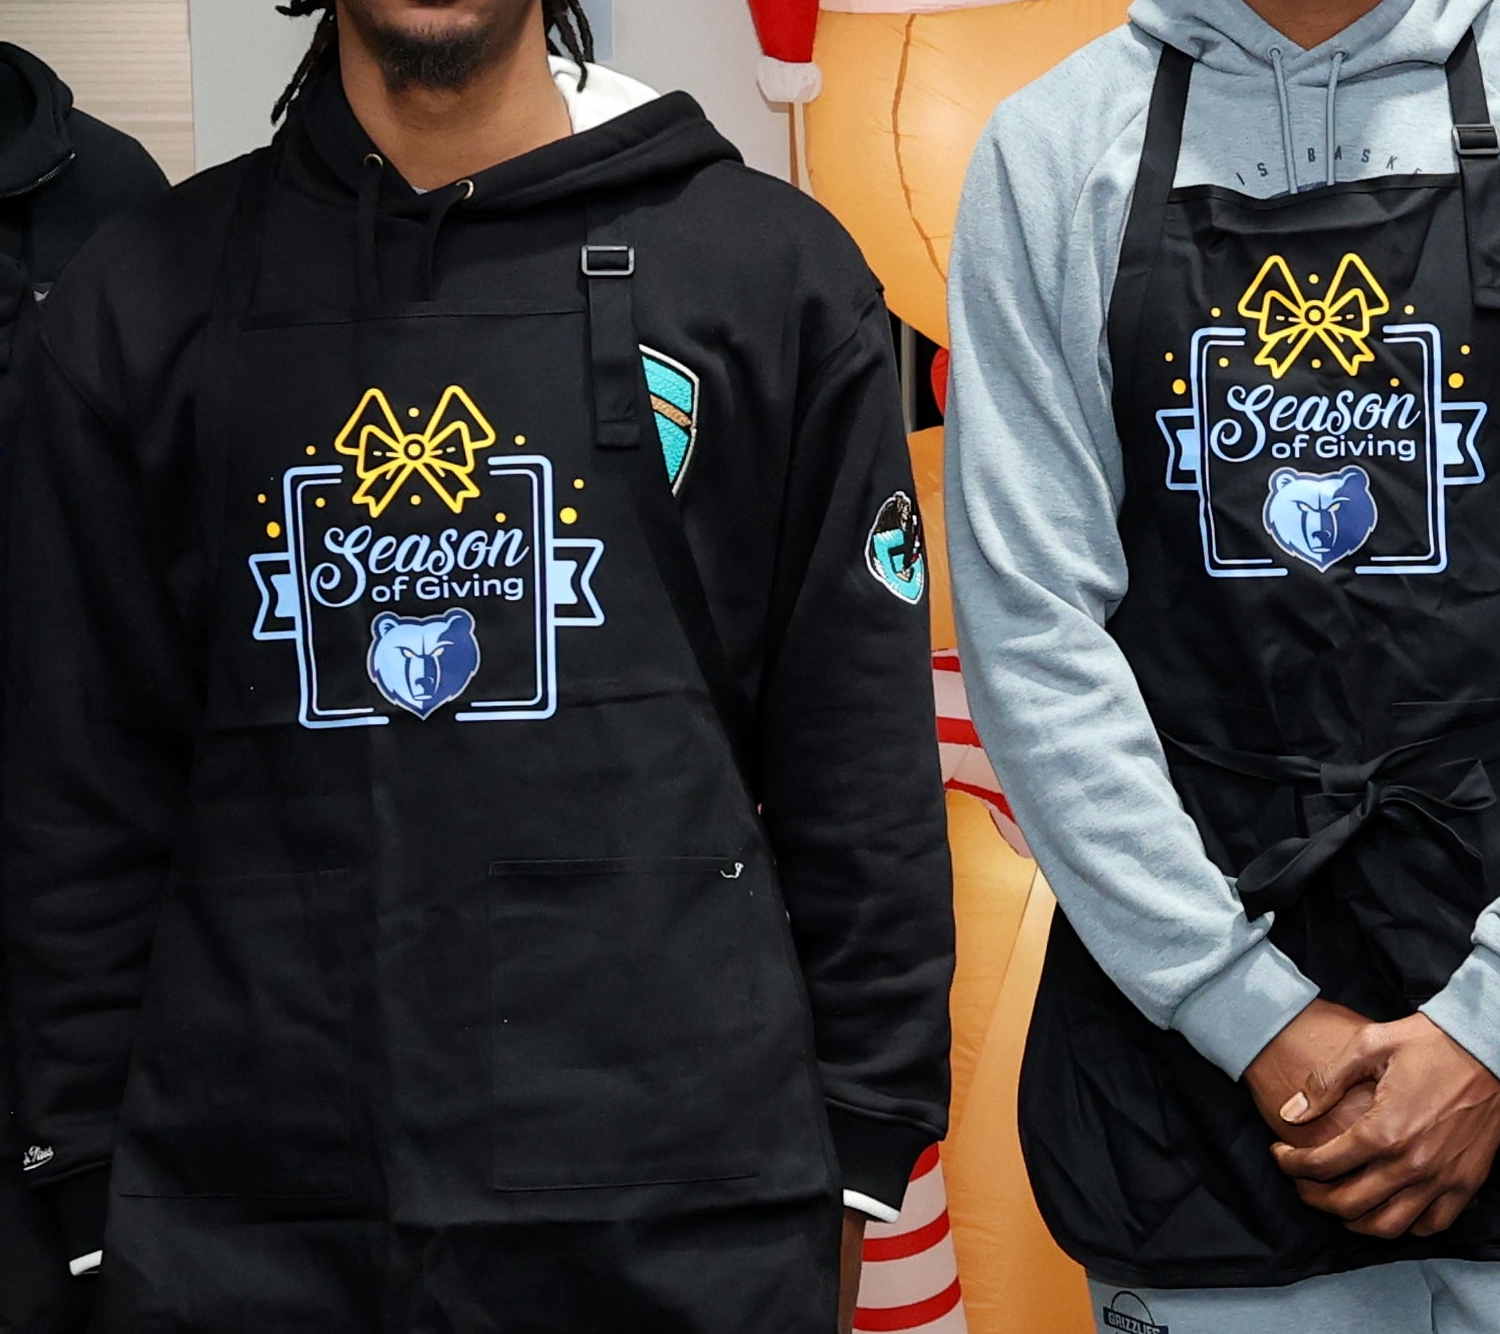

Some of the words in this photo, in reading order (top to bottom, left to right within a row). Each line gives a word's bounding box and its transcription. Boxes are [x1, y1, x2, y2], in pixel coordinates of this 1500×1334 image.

[1209, 384, 1421, 463] Season
[1271, 434, 1310, 459] of
[1315, 434, 1416, 462] Giving
[310, 525, 530, 608] Season
[371, 575, 410, 603] of
[415, 576, 524, 601] Giving
